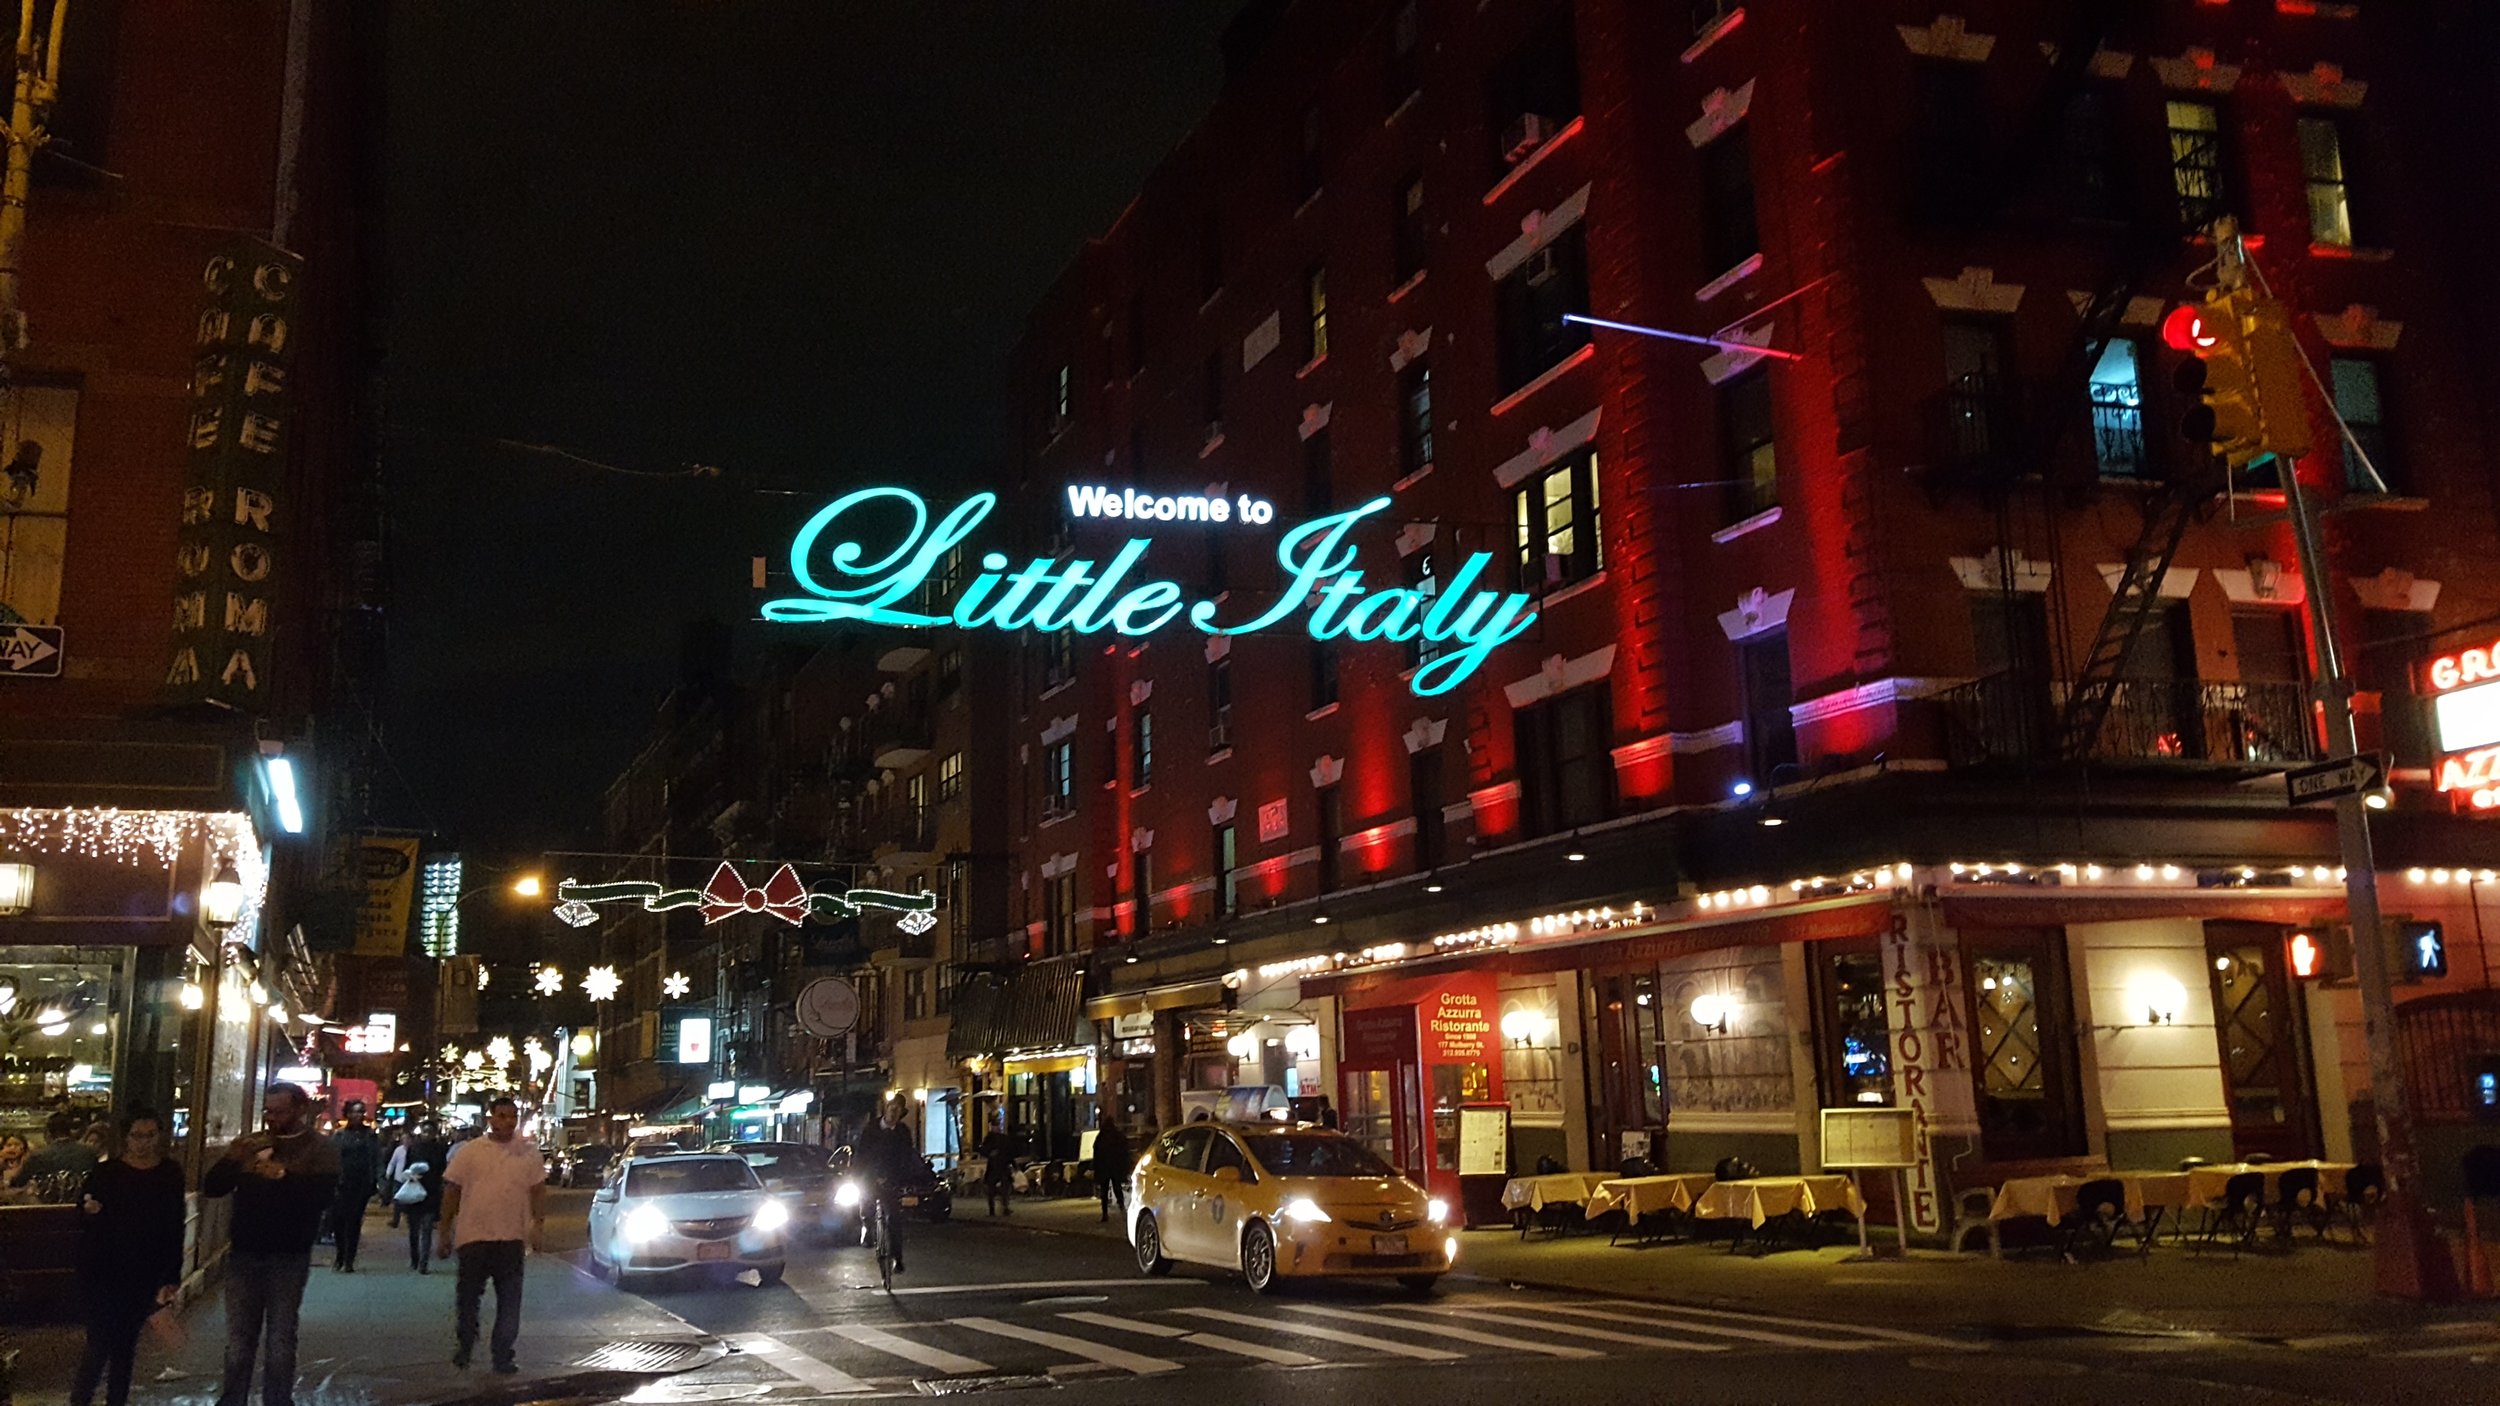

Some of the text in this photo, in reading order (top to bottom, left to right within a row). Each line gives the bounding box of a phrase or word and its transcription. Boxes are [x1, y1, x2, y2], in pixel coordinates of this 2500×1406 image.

[220, 262, 292, 692] CAFE ROMA
[1067, 485, 1274, 525] Welcome to
[760, 487, 1538, 697] Little Italy
[2299, 773, 2327, 793] ONE
[1437, 1006, 1482, 1019] Azzurra
[1440, 992, 1477, 1006] Grotta
[1927, 951, 1966, 1069] BAR
[1430, 1019, 1490, 1033] Ristorante
[1889, 914, 1935, 1227] RISTORANTE
